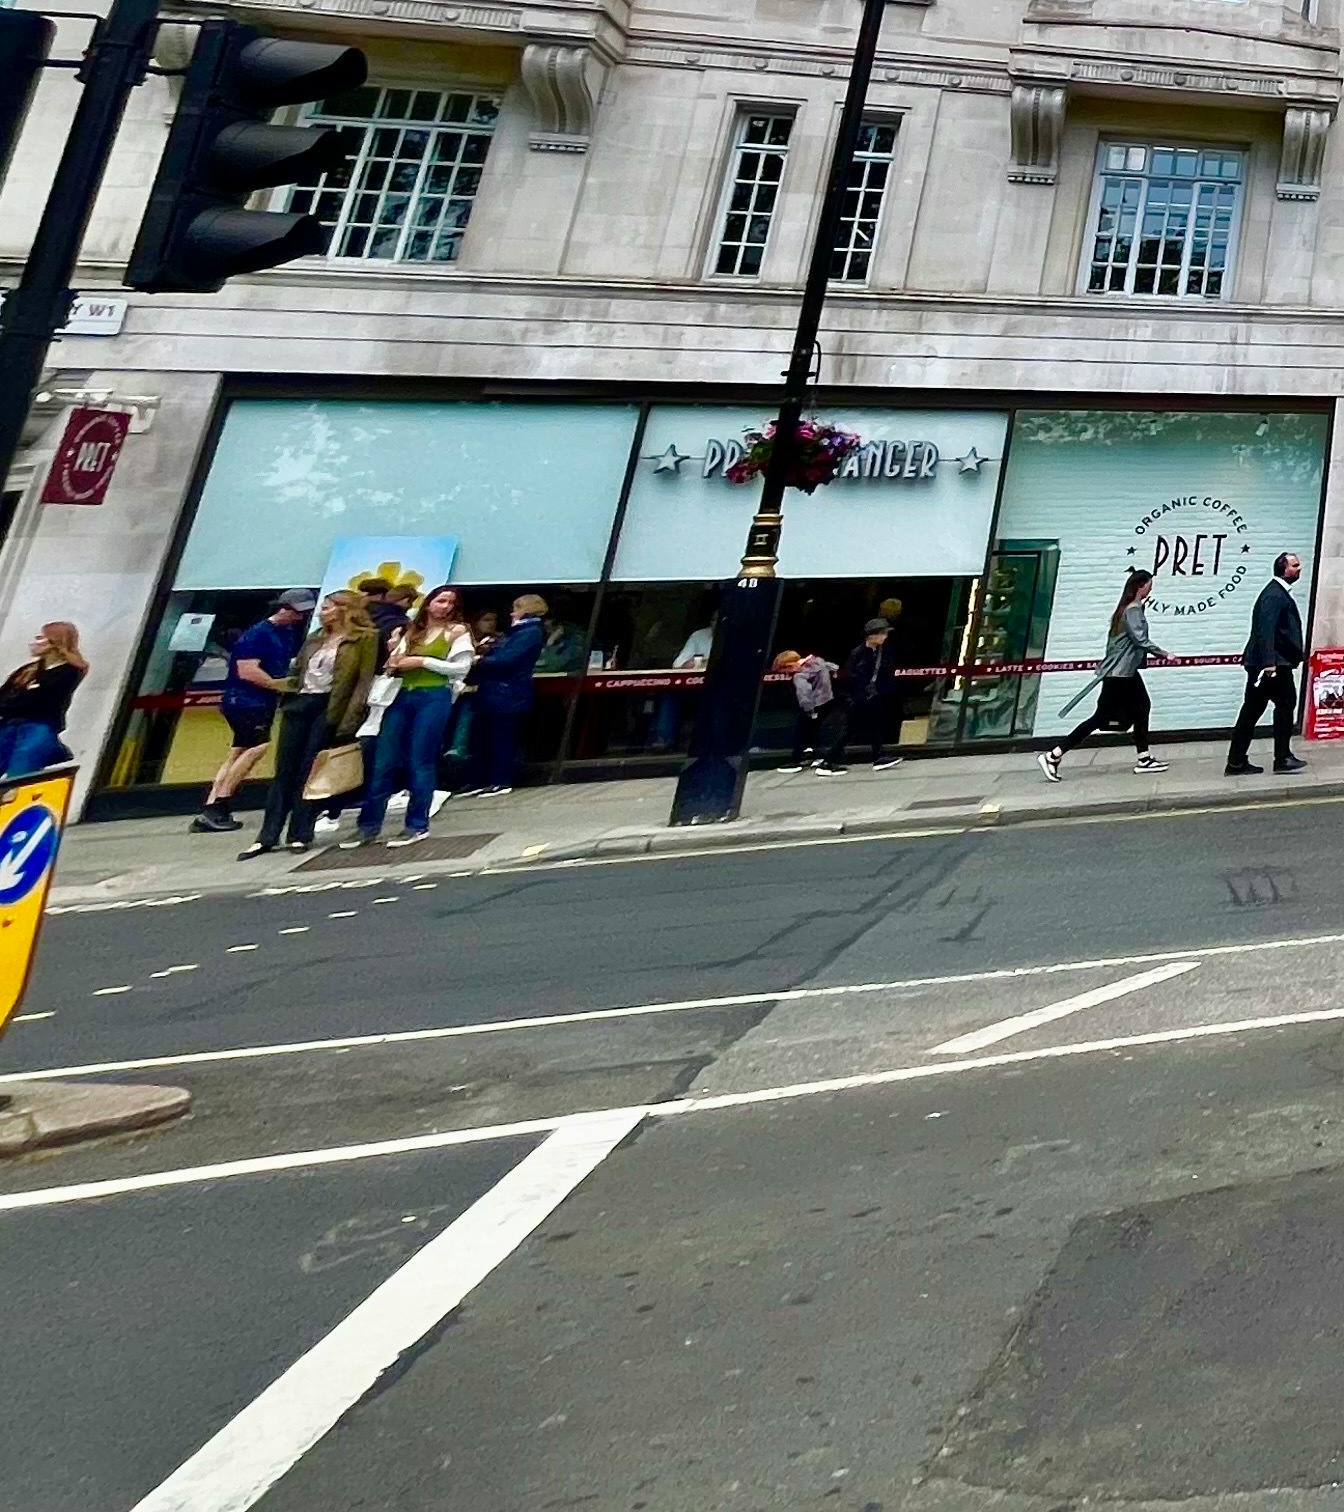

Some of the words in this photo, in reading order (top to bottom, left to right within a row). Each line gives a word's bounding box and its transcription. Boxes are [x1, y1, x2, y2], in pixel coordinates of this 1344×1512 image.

[89, 304, 116, 317] W1
[1135, 496, 1197, 535] ORGANIC
[1202, 497, 1248, 535] COFFEE
[1152, 534, 1228, 576] PRET
[1174, 596, 1217, 615] MADE
[1218, 565, 1247, 599] FOOD
